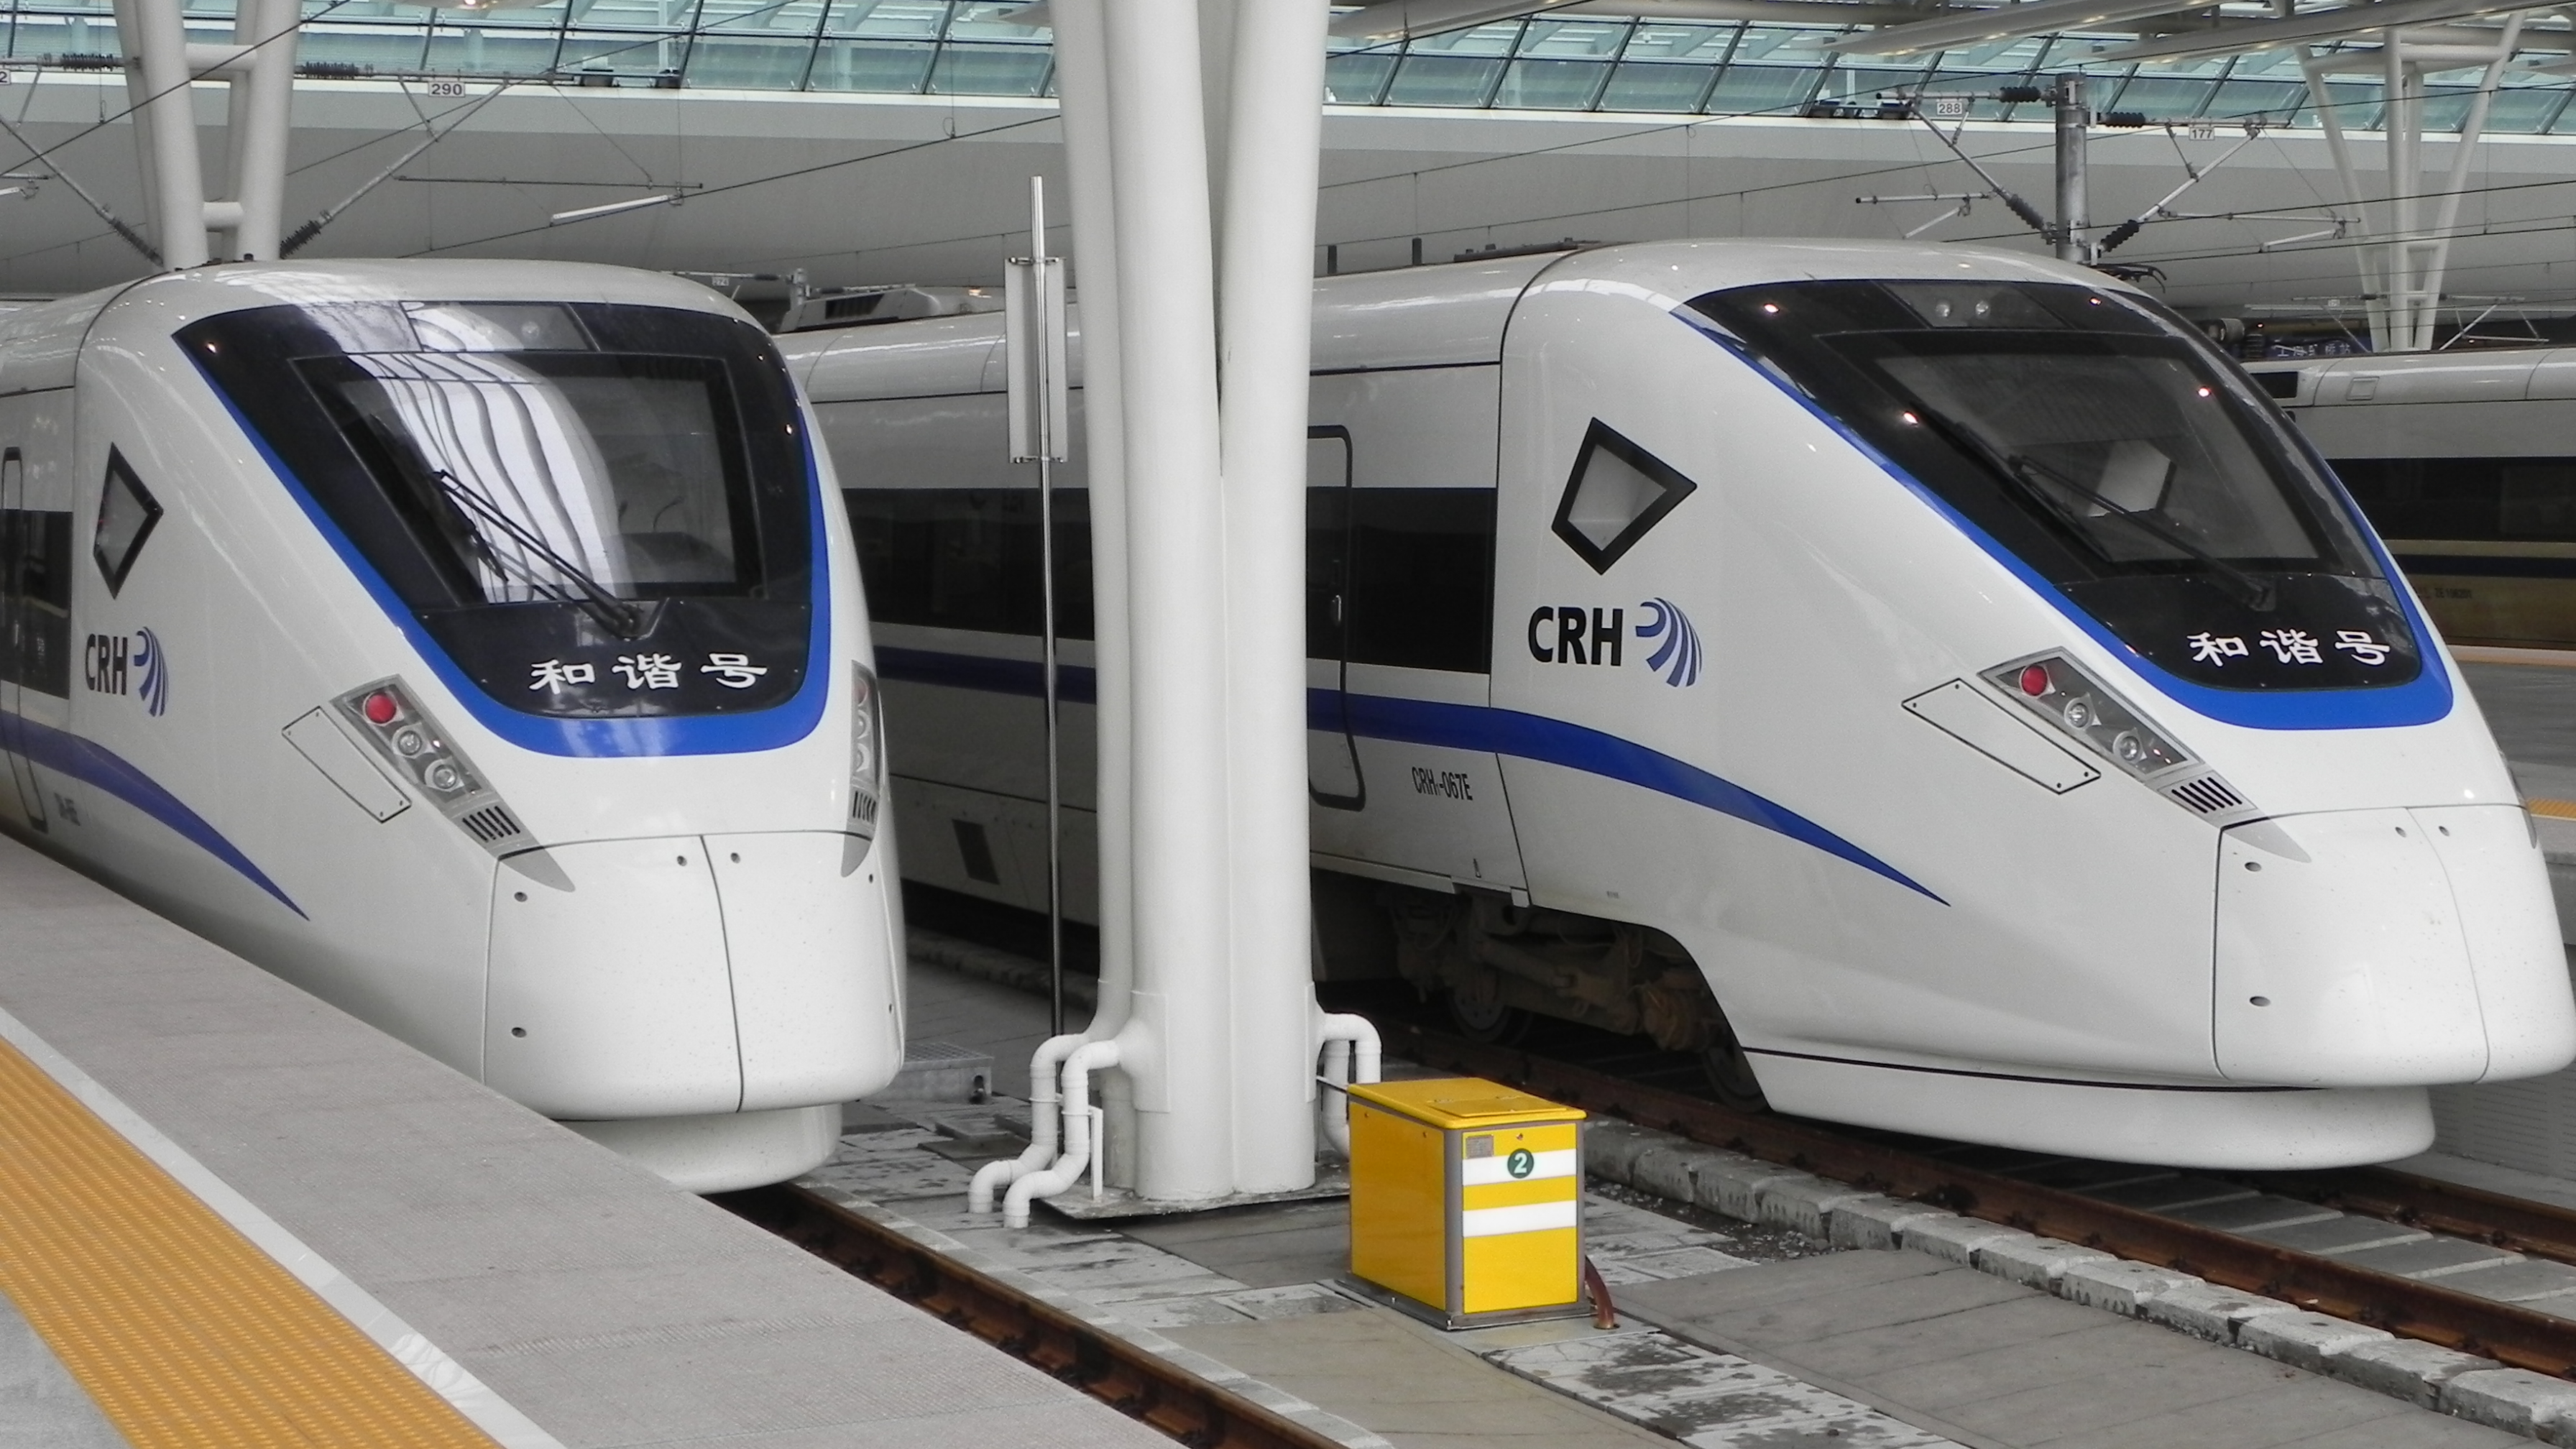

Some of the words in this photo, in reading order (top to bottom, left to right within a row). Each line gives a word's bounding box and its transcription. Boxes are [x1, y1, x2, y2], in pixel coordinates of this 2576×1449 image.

[431, 83, 462, 96] 290
[1938, 103, 1961, 114] 288
[2192, 129, 2213, 139] 177
[1528, 606, 1623, 666] CRH
[2186, 629, 2391, 667] 和谐号
[86, 633, 128, 695] CRH
[529, 653, 768, 695] 和谐号
[1514, 1152, 1527, 1174] 2
